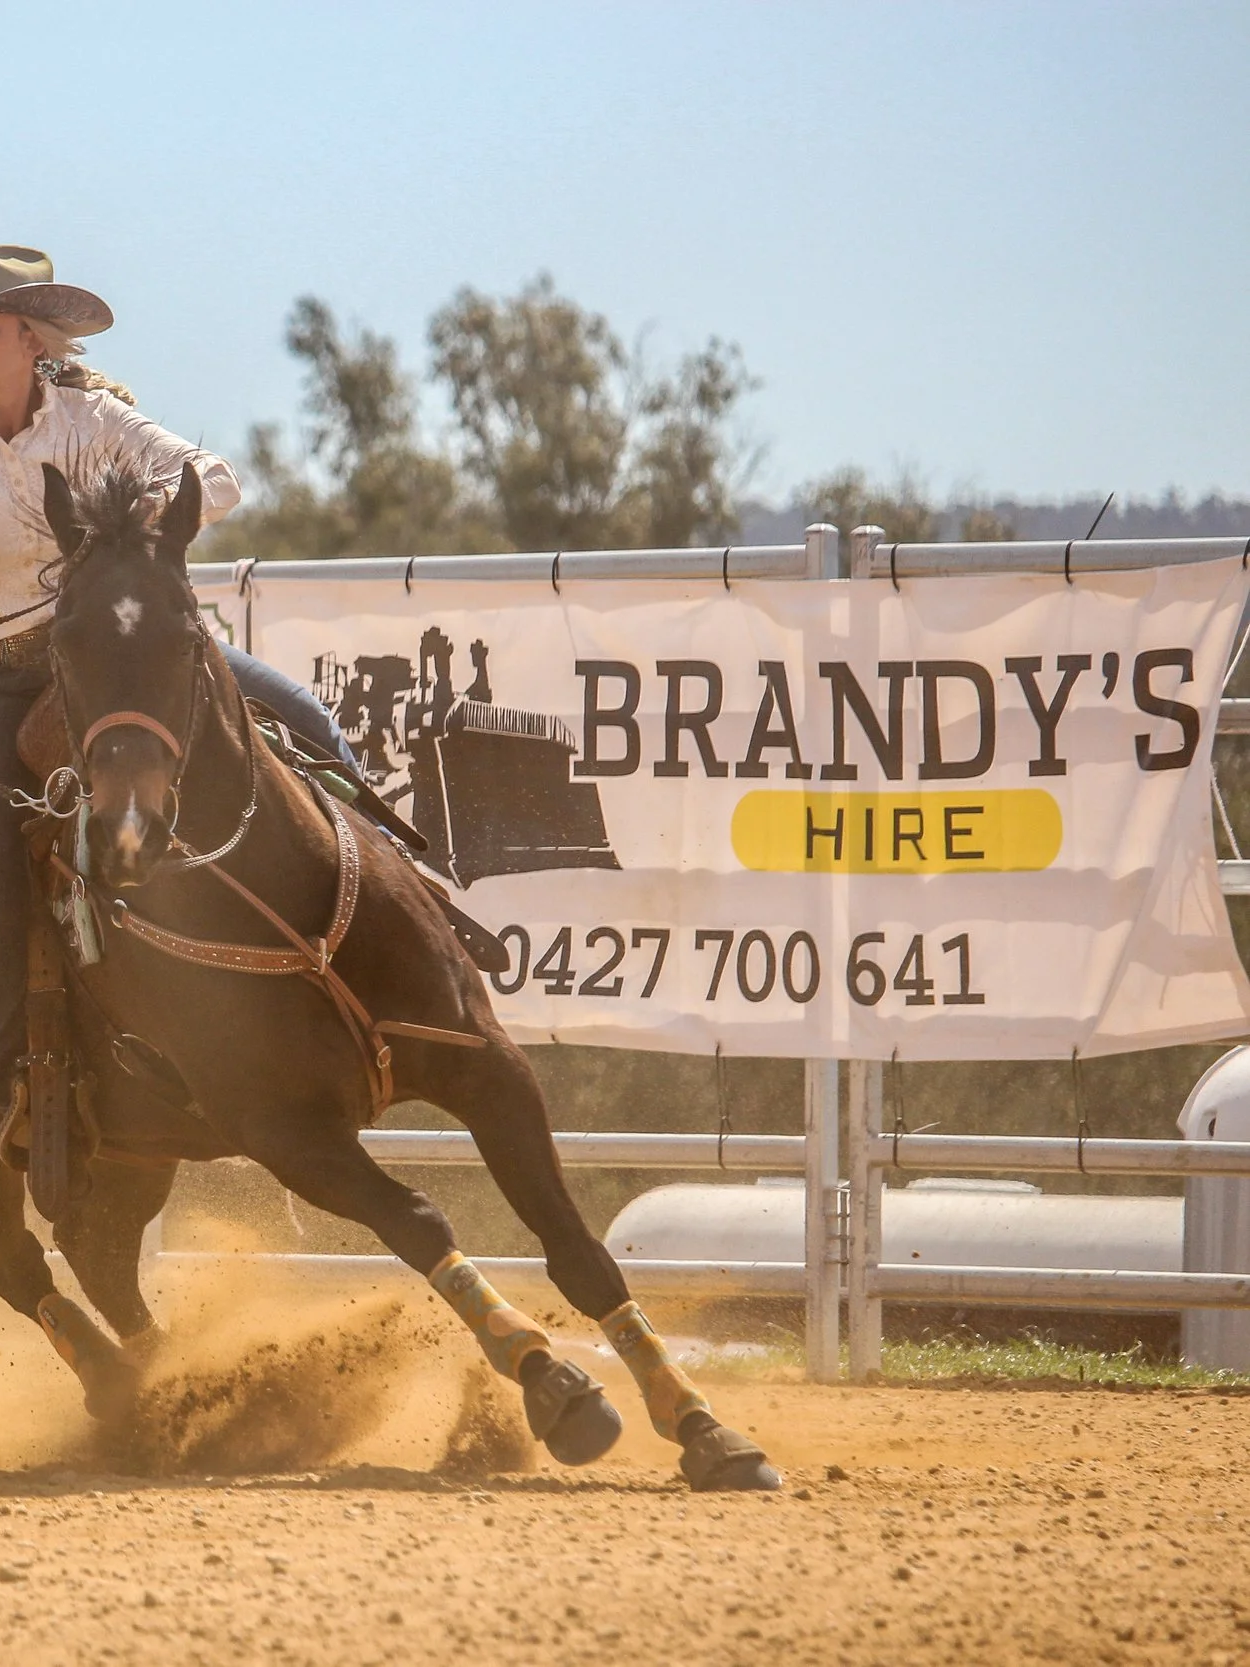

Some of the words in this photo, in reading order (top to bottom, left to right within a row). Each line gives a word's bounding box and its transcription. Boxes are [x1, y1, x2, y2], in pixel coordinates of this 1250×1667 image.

[572, 647, 1201, 781] BRANDY'S
[805, 805, 986, 861] HIRE
[490, 924, 670, 999] 0427
[694, 929, 821, 1003] 700
[847, 932, 986, 1006] 641
